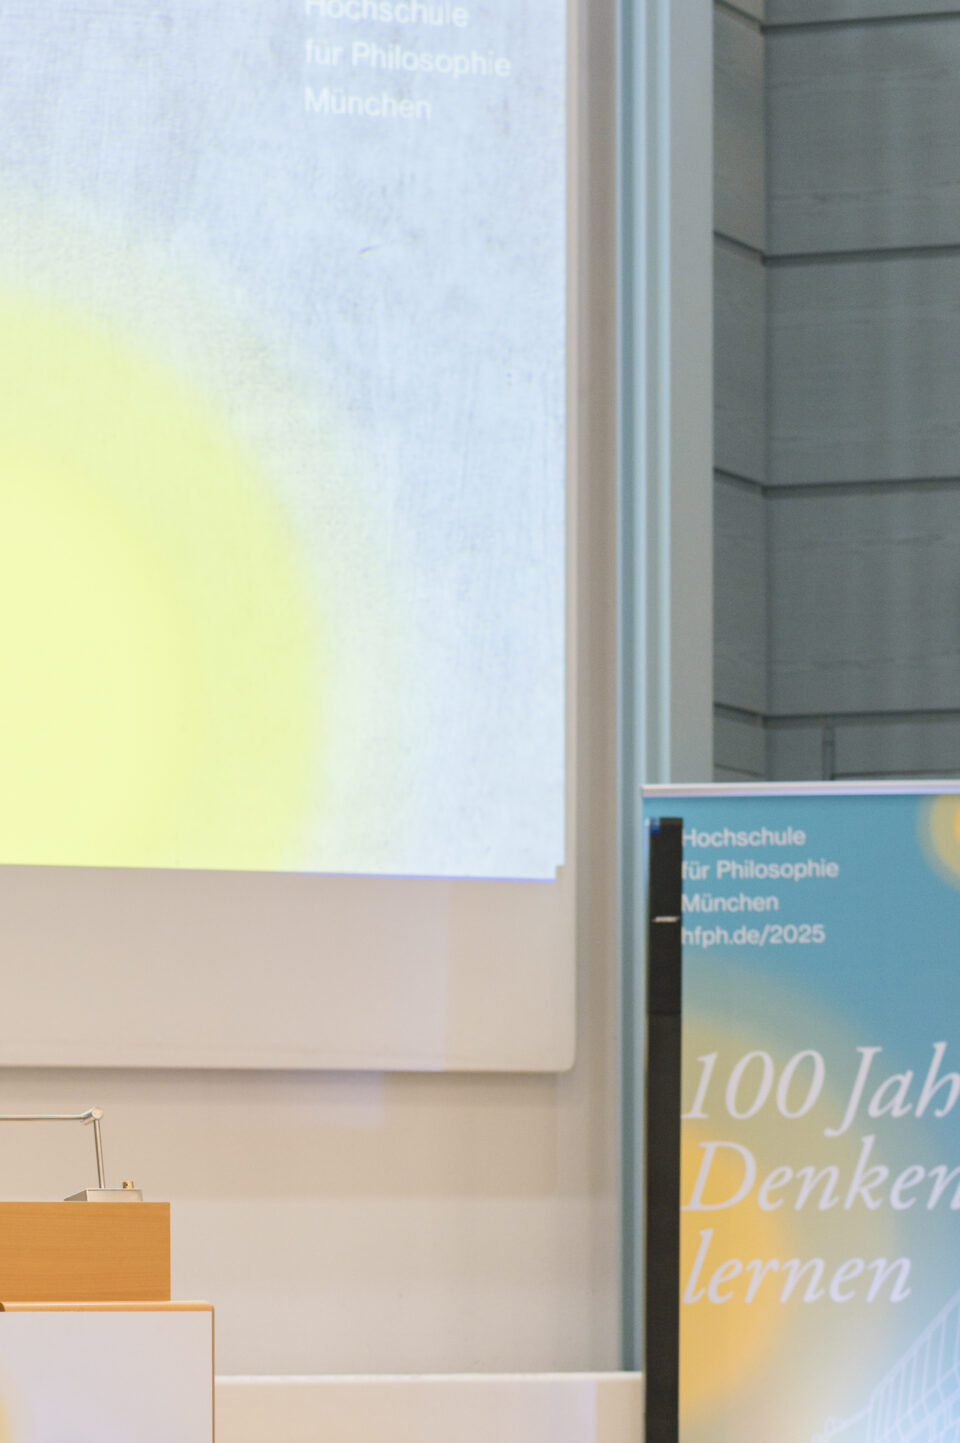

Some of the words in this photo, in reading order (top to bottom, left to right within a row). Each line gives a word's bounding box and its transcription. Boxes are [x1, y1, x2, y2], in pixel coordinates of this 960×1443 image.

[305, 39, 342, 65] für
[352, 41, 512, 78] Philosophie
[304, 87, 432, 119] München
[682, 827, 807, 848] Hochschule
[681, 861, 709, 881] für
[716, 859, 839, 882] Philosophie
[681, 893, 779, 912] München
[681, 924, 826, 948] hfph.de/2025
[681, 1049, 825, 1119] 100
[683, 1227, 912, 1304] lernen
